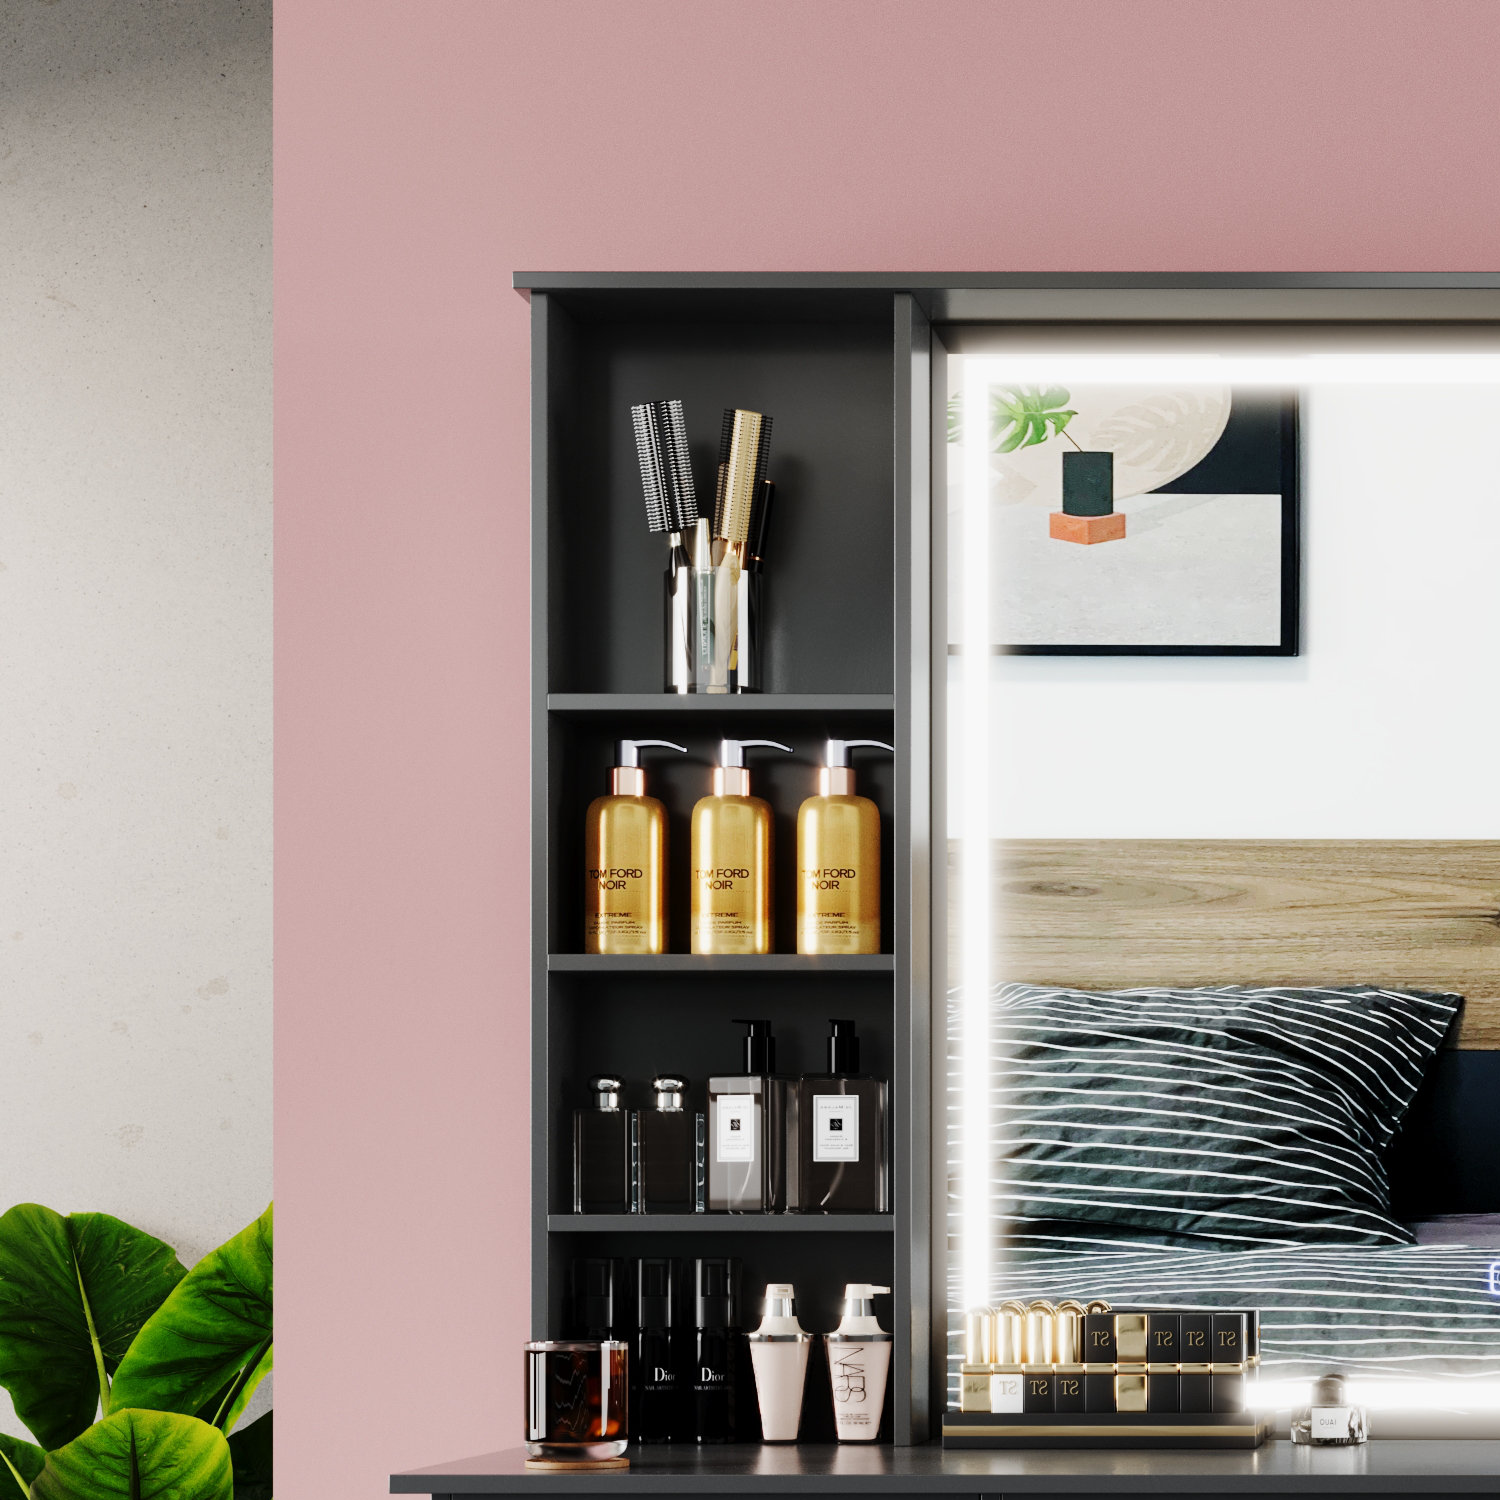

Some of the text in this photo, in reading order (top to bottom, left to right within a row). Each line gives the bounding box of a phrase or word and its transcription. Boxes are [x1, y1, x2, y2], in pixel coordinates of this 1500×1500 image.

[589, 868, 643, 879] TOM FORD
[717, 868, 750, 878] FORD
[823, 868, 856, 878] FORD
[599, 880, 626, 890] NOIR
[706, 880, 733, 890] NOIR
[812, 880, 840, 890] NOIR
[654, 1367, 675, 1381] Dior
[702, 1367, 725, 1381] Dior
[834, 1347, 867, 1402] NARS
